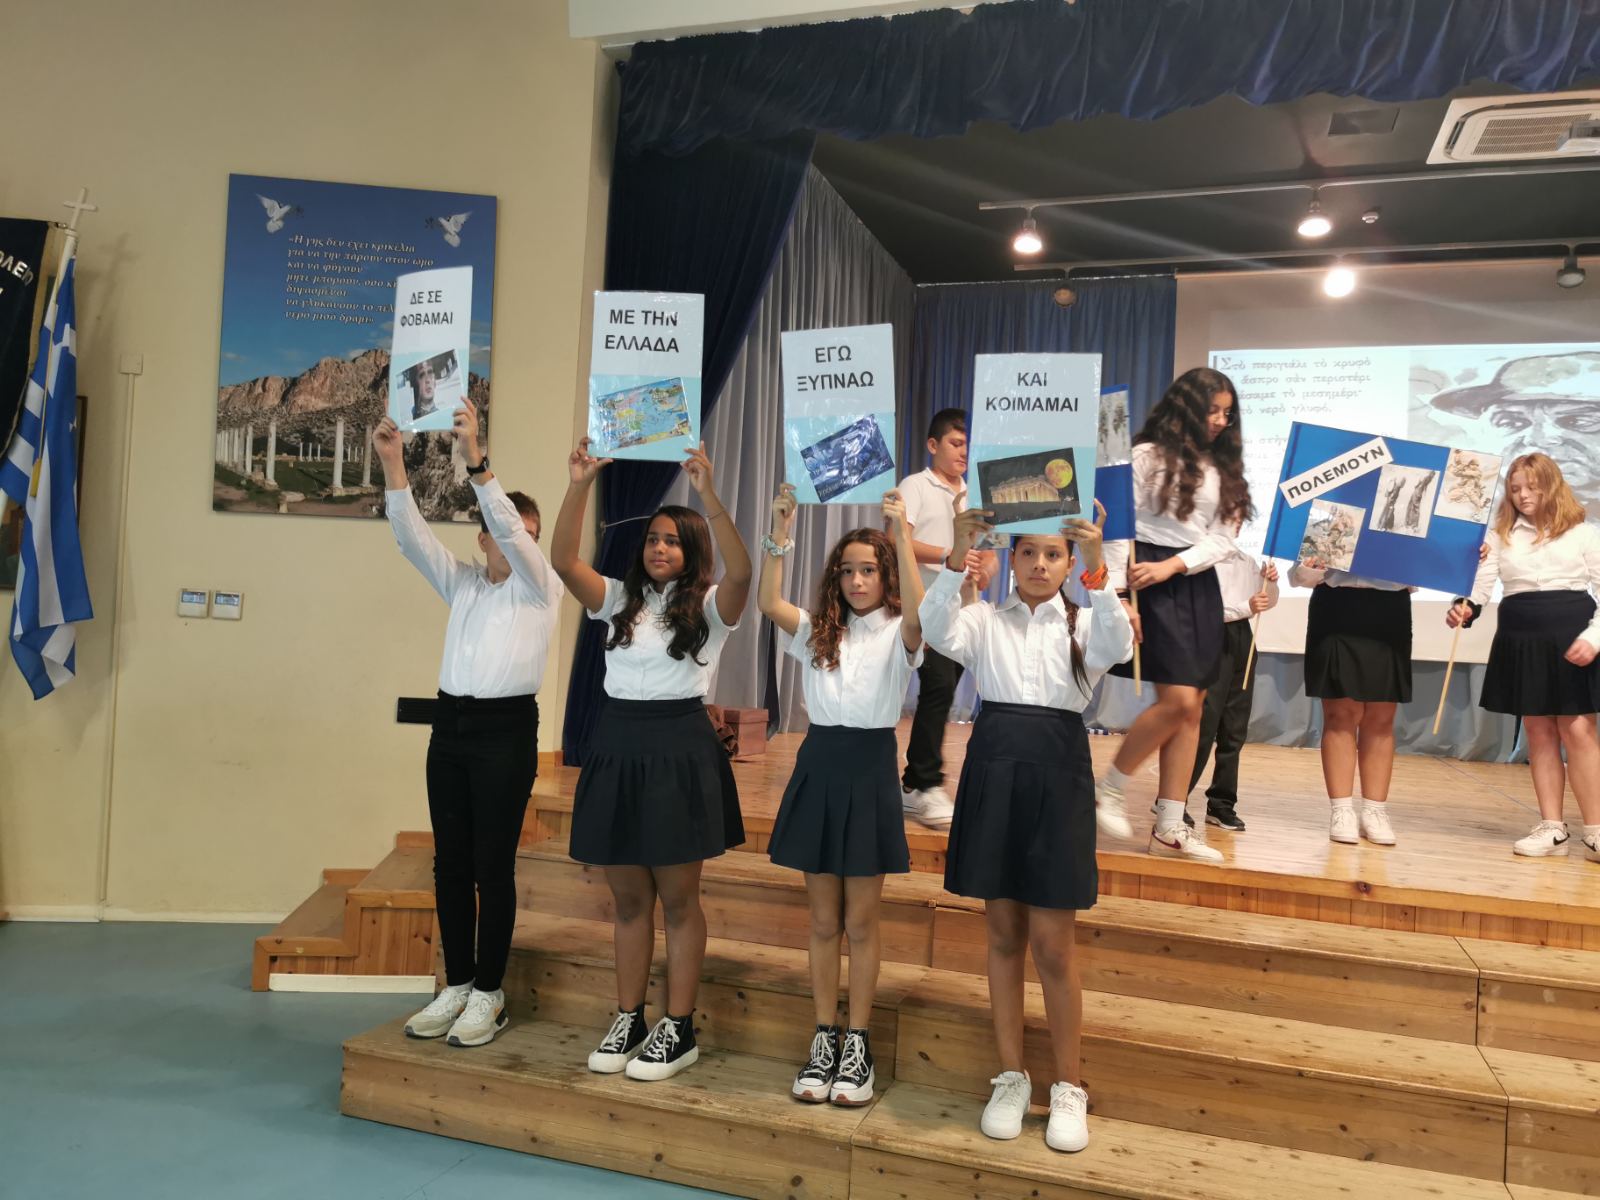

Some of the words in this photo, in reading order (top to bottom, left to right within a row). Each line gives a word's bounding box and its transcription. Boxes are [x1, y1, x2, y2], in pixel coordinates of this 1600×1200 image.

[326, 237, 345, 246] δεν
[287, 248, 304, 257] για
[307, 248, 320, 257] να
[323, 249, 341, 260] την
[385, 255, 410, 264] στον
[307, 262, 320, 270] να
[410, 291, 424, 305] ΔΕ
[427, 290, 443, 303] ΣΕ
[362, 303, 374, 311] το
[400, 312, 453, 327] ΦΟΒΑΜΑΙ
[609, 308, 635, 325] ΜΕ
[641, 310, 678, 327] ΤΗΝ
[604, 334, 680, 353] ΕΛΛΑΔΑ
[815, 345, 852, 363] ΕΓΩ
[797, 371, 875, 392] ΞΥΠΝΑΩ
[1017, 372, 1047, 387] ΚΑΙ
[985, 396, 1079, 413] ΚΟΙΜΑΜΑΙ
[1287, 445, 1385, 499] ΠΟΛΕΜΟΥΝ
